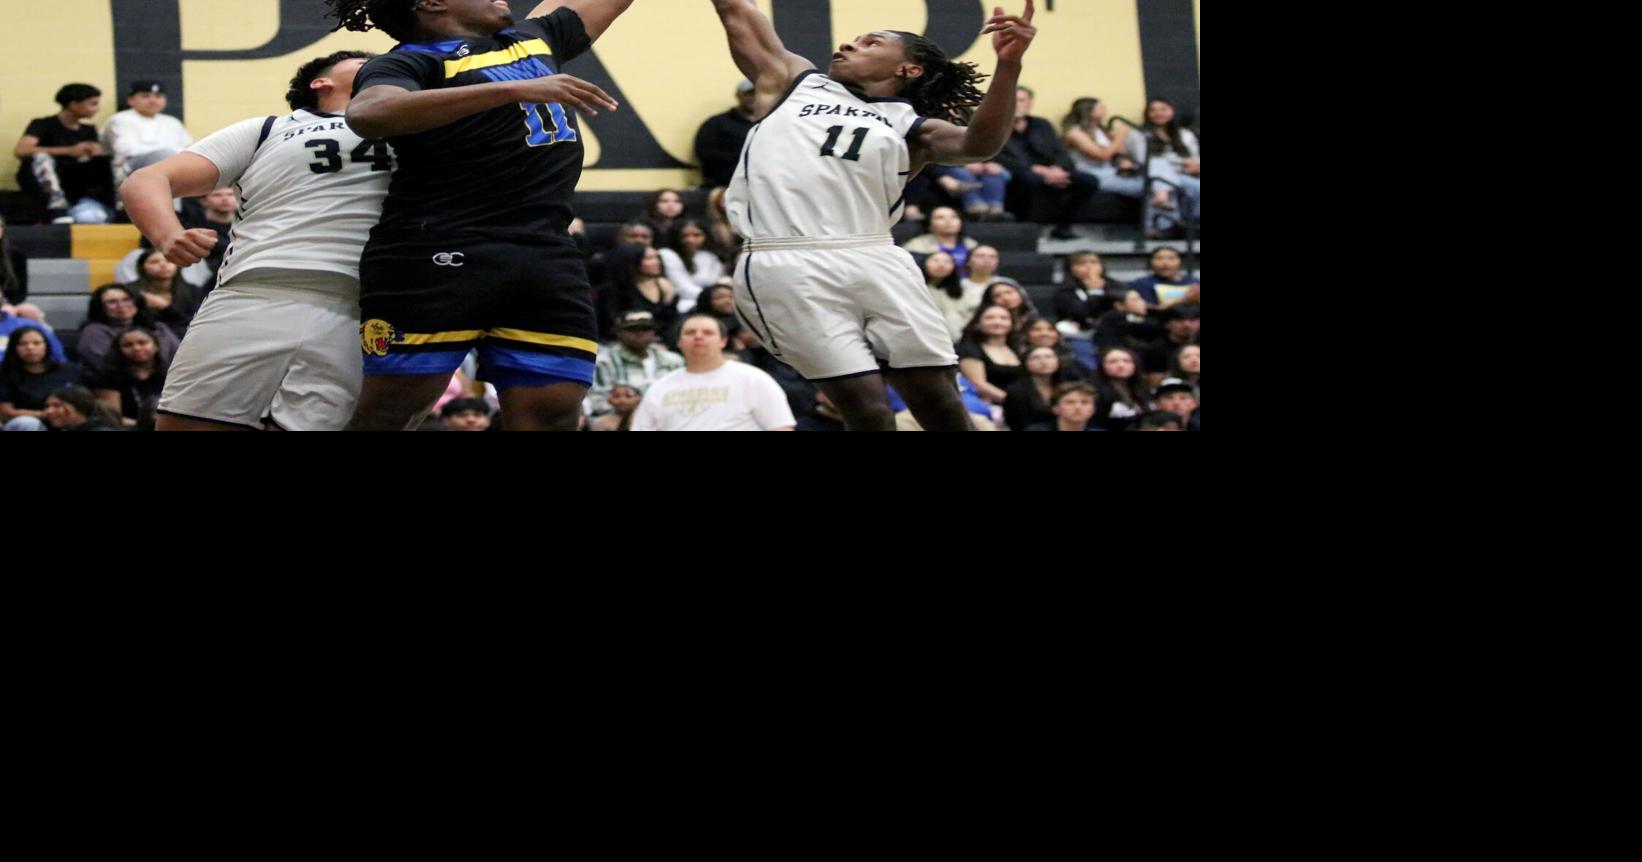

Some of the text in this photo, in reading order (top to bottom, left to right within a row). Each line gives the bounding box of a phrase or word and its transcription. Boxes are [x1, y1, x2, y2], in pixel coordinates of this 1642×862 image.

[283, 122, 344, 141] SPAR
[820, 125, 870, 162] 11
[304, 138, 392, 174] 34
